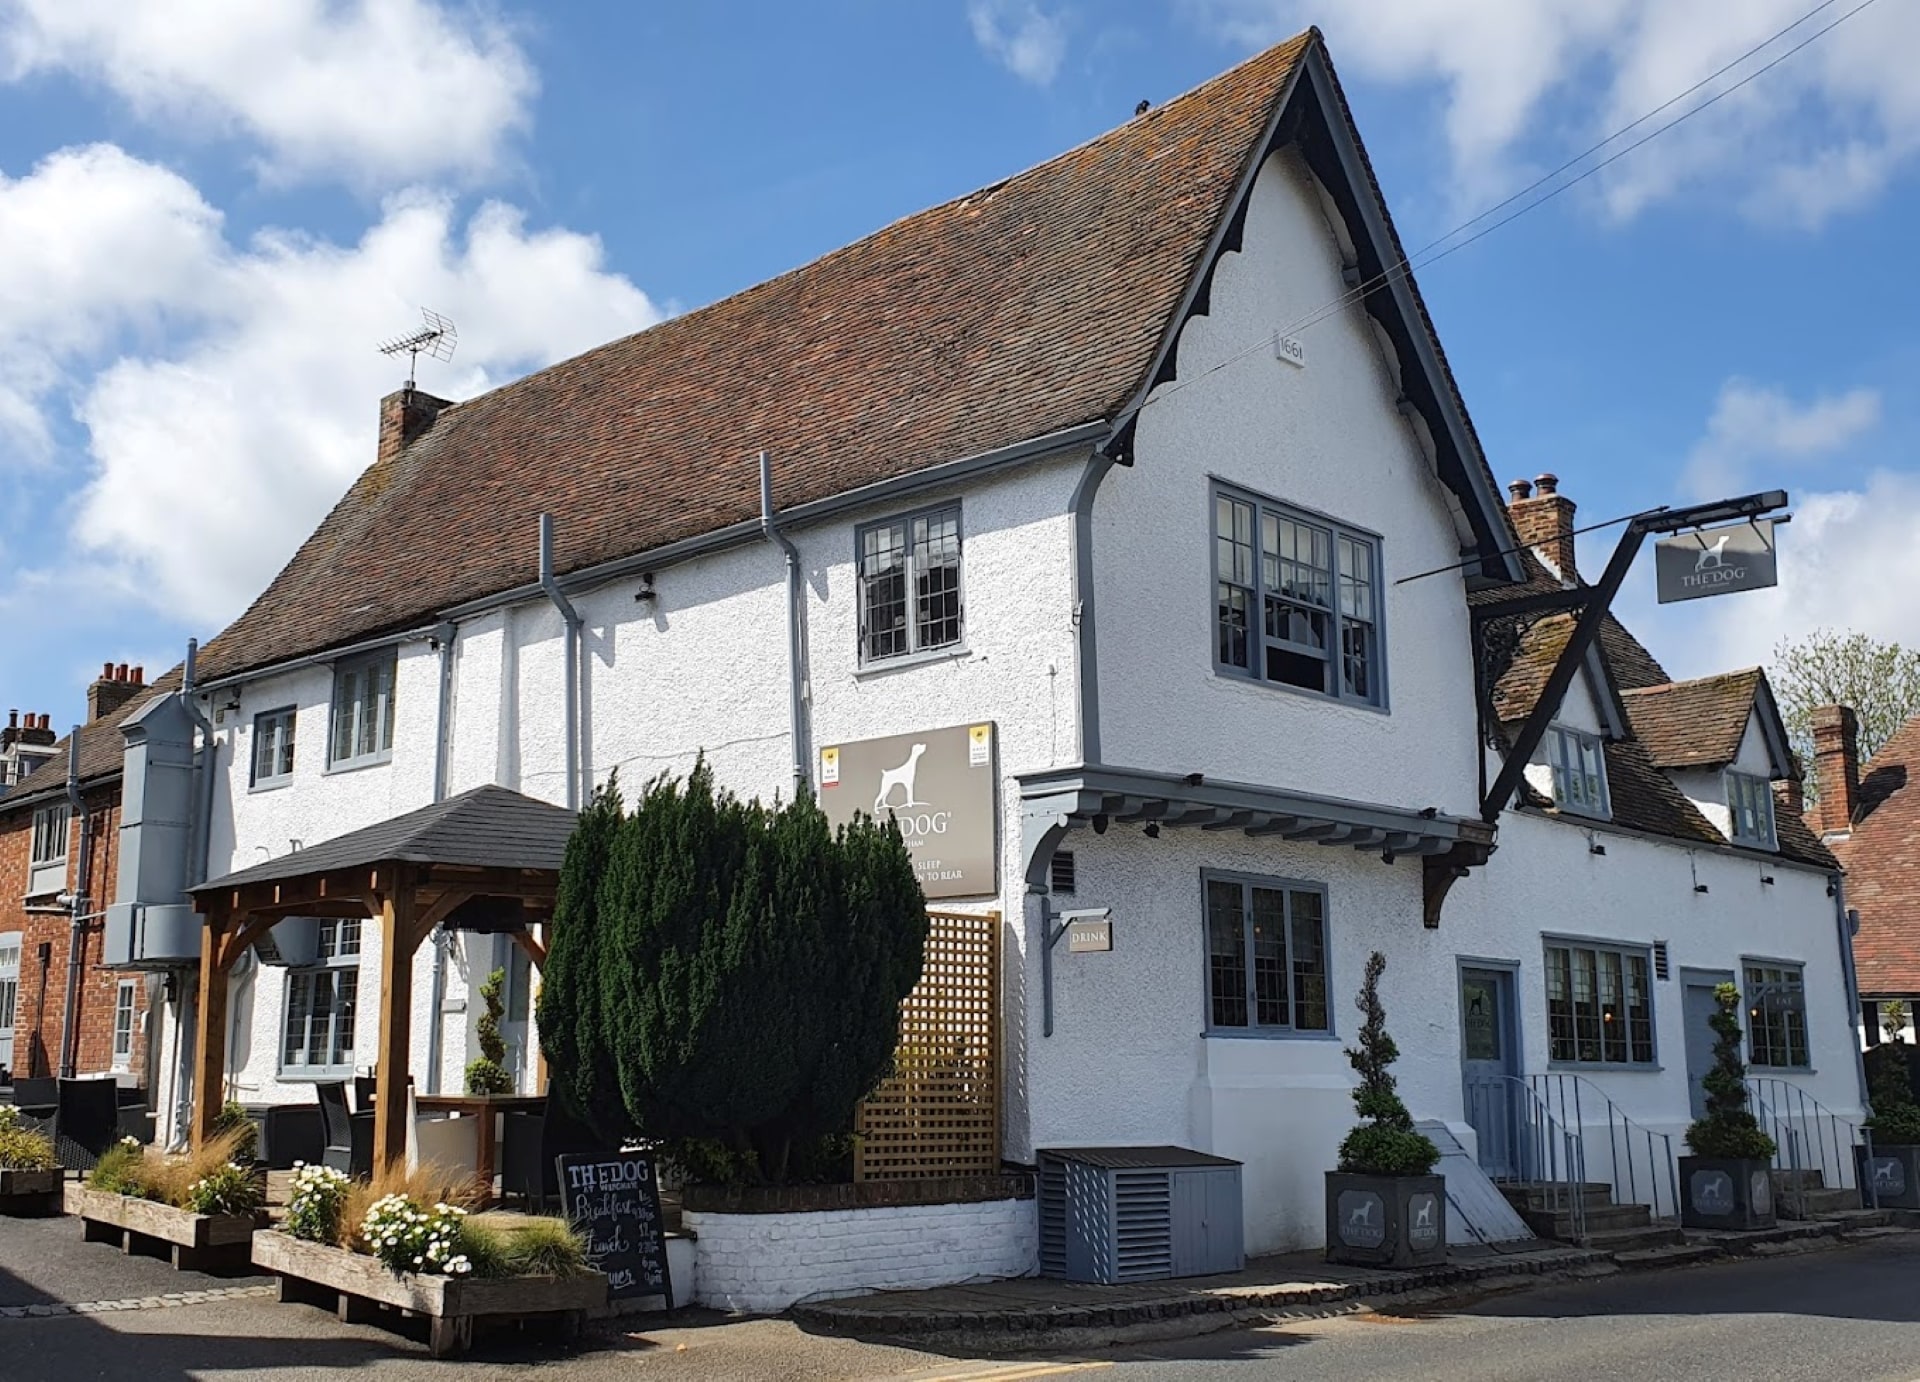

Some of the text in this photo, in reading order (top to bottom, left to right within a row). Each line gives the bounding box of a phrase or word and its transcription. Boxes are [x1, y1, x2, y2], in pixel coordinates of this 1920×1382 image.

[1280, 337, 1303, 360] 1661
[1680, 572, 1711, 586] THE
[1711, 567, 1745, 582] DOG
[896, 812, 948, 838] DOG
[918, 860, 941, 871] SLEEP
[928, 872, 939, 880] TO
[940, 870, 963, 880] REAR
[1072, 931, 1106, 943] DRINK
[568, 1159, 648, 1188] THE DOG
